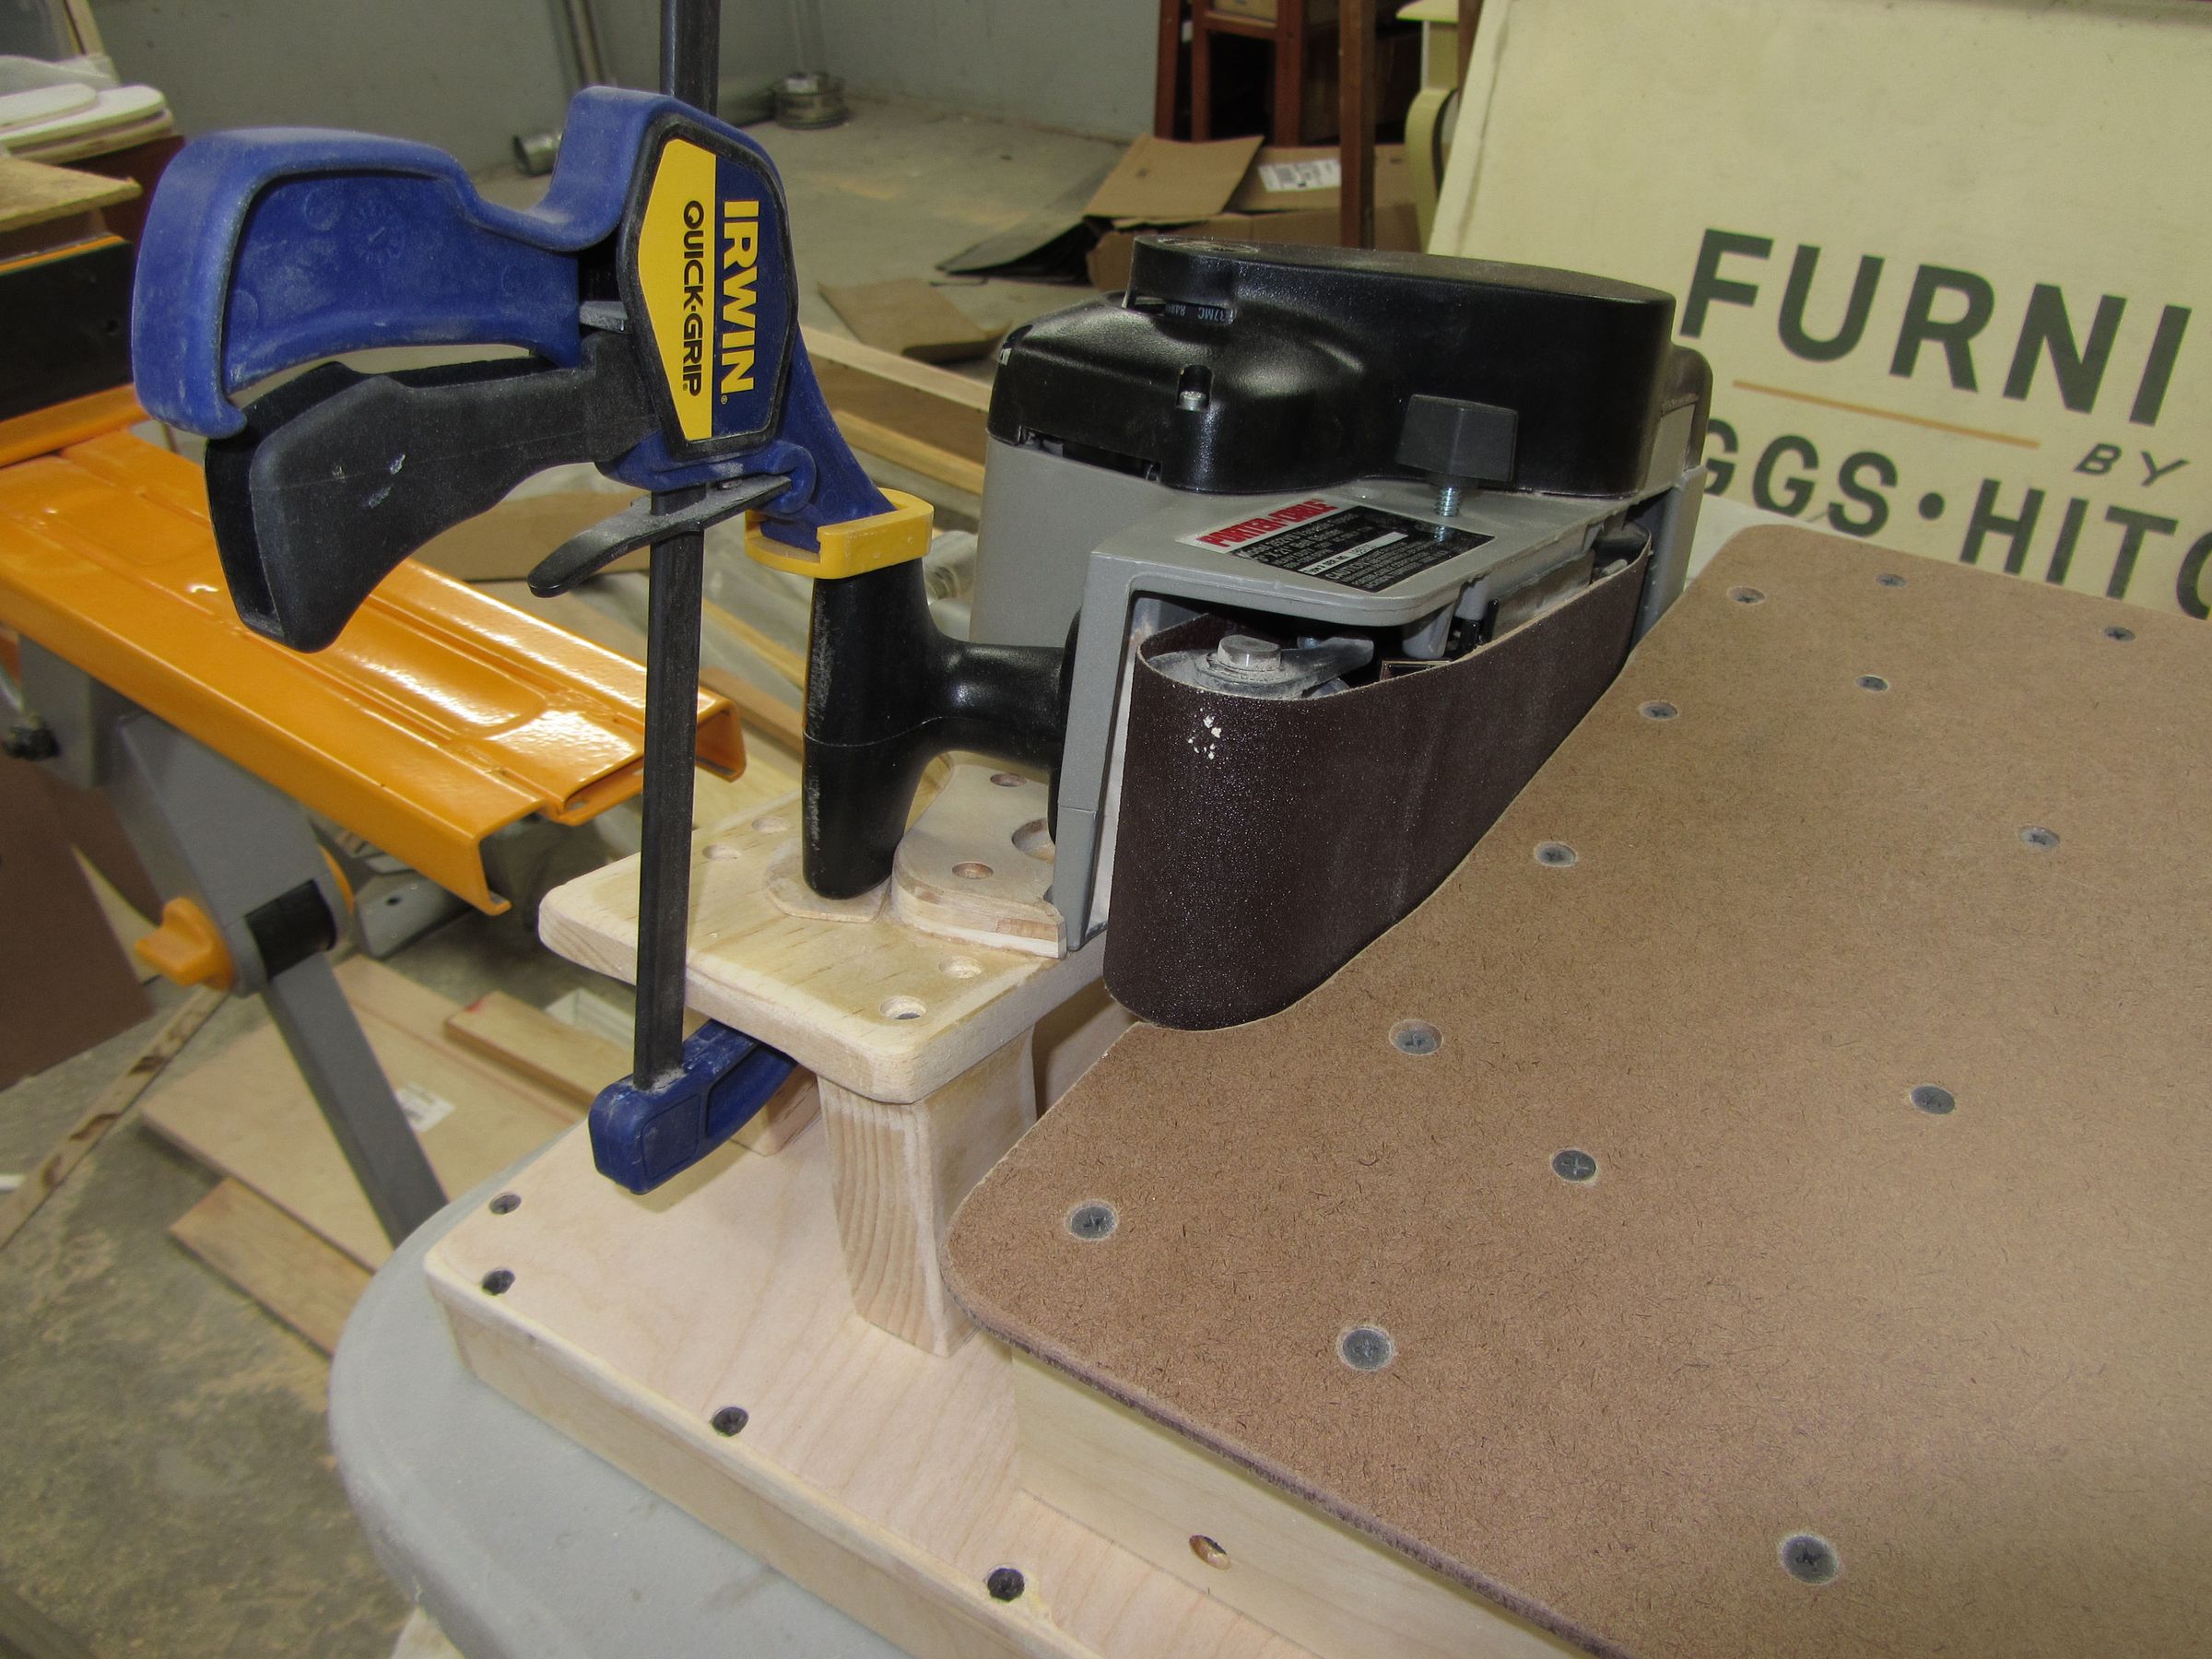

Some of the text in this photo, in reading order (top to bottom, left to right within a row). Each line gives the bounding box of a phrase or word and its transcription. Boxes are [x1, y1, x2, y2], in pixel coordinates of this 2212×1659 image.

[683, 200, 704, 396] QUICK-GRIP
[722, 199, 759, 394] IRWIN
[1679, 228, 2192, 427] FURNI
[2075, 442, 2190, 487] BY
